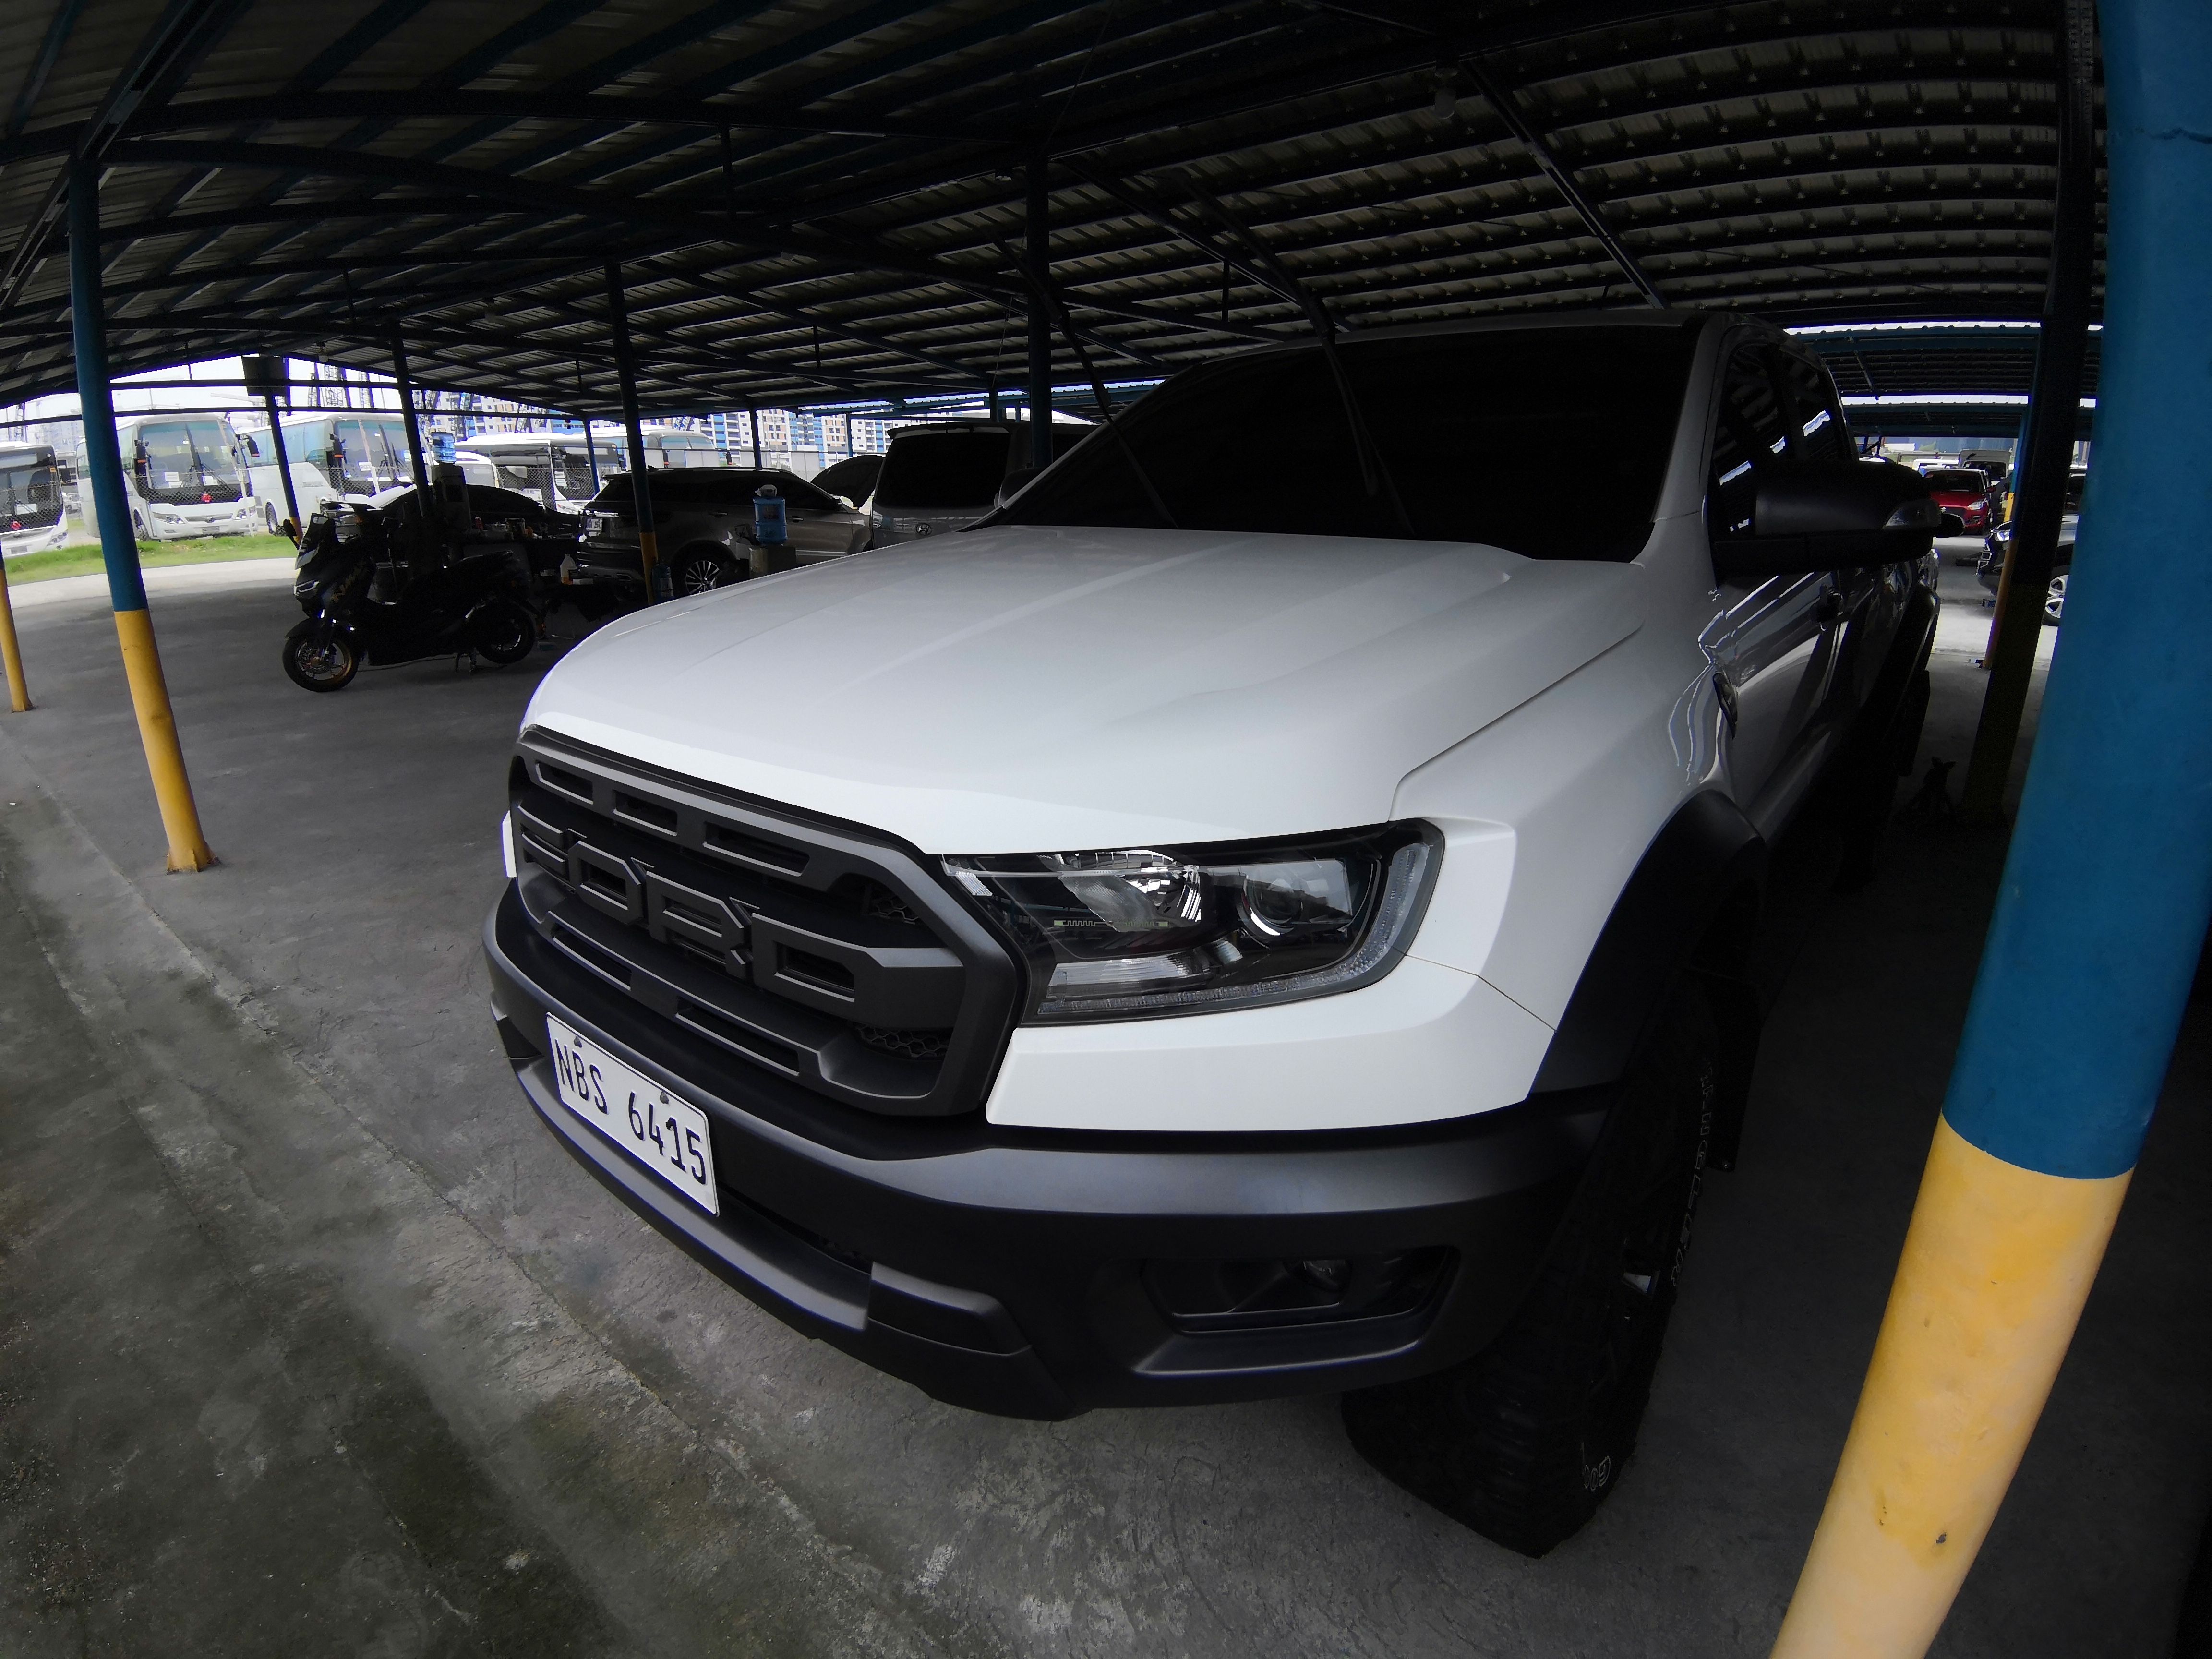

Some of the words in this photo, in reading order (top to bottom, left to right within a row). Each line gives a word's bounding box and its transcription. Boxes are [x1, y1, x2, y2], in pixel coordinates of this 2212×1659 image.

[517, 804, 884, 1028] FORD
[555, 1038, 609, 1115] NBS
[628, 1090, 707, 1185] 6415
